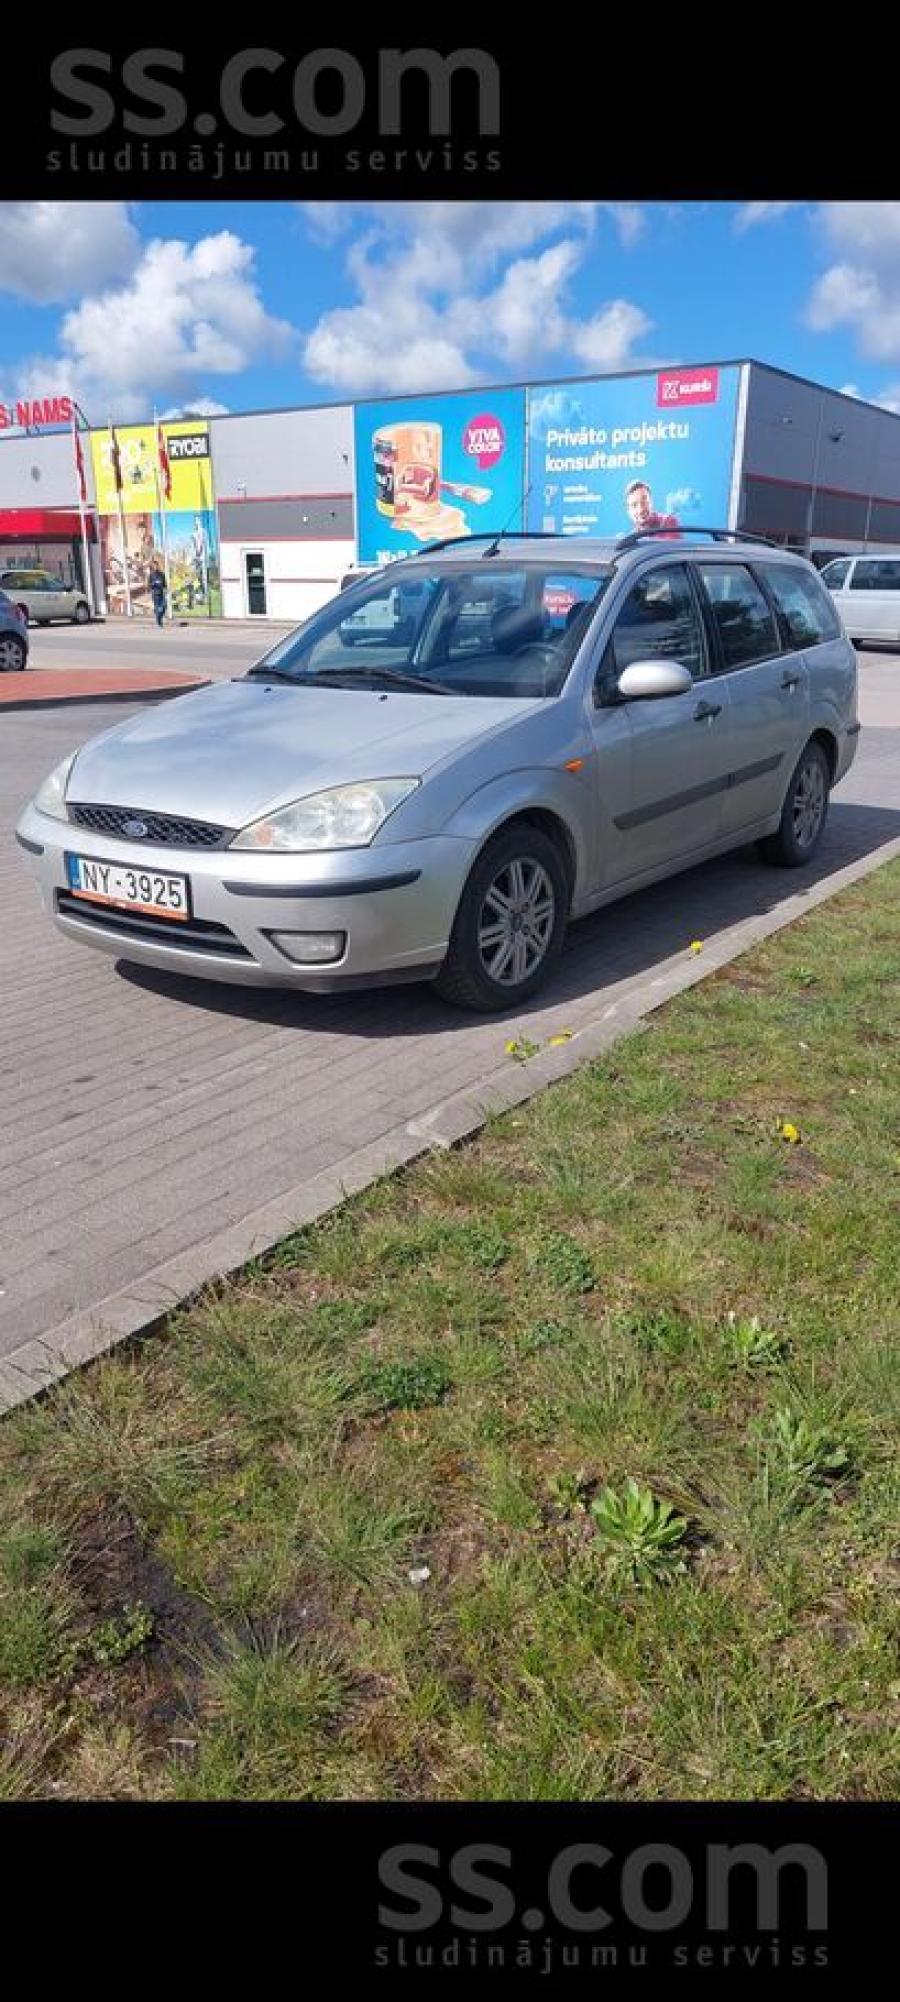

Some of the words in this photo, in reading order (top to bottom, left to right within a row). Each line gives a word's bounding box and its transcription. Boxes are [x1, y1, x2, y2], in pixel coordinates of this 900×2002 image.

[17, 396, 73, 427] NAMS
[168, 437, 208, 457] RYOBI
[468, 428, 500, 443] VIVA
[546, 426, 608, 448] Privāto
[611, 421, 690, 447] projektu
[545, 449, 646, 472] konsultants
[83, 862, 182, 908] NY-3925
